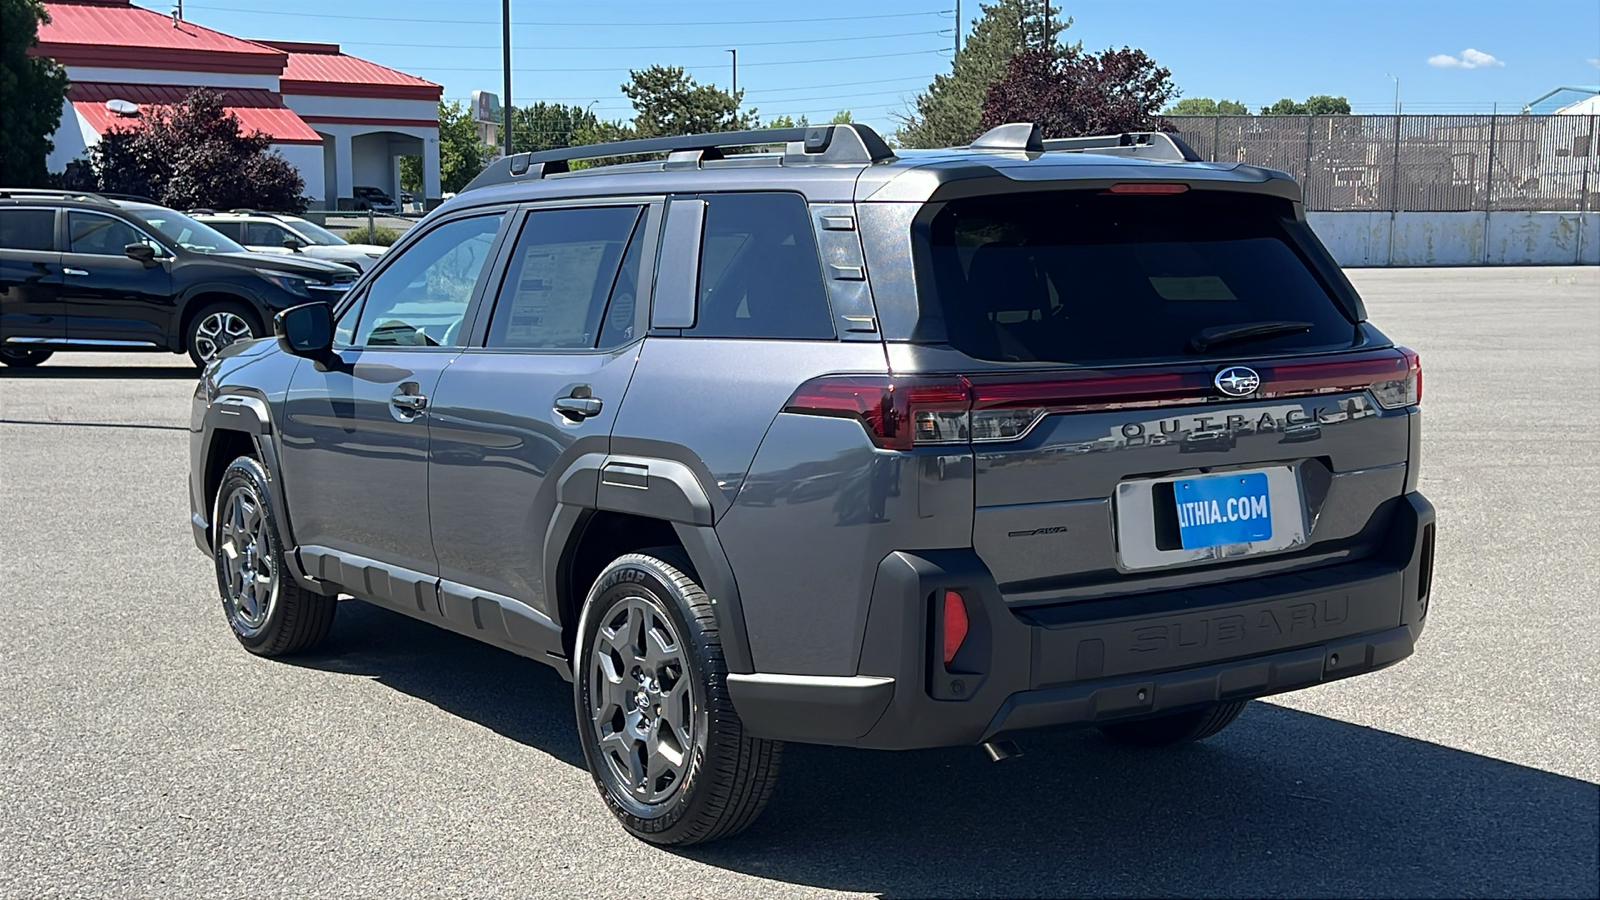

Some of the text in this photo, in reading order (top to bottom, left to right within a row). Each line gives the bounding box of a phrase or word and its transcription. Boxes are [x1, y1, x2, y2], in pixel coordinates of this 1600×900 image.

[1121, 407, 1329, 440] OUTBACK
[1177, 494, 1268, 528] LITHIA.COM
[597, 568, 646, 596] DUNLOP
[1130, 595, 1349, 653] SUBARU
